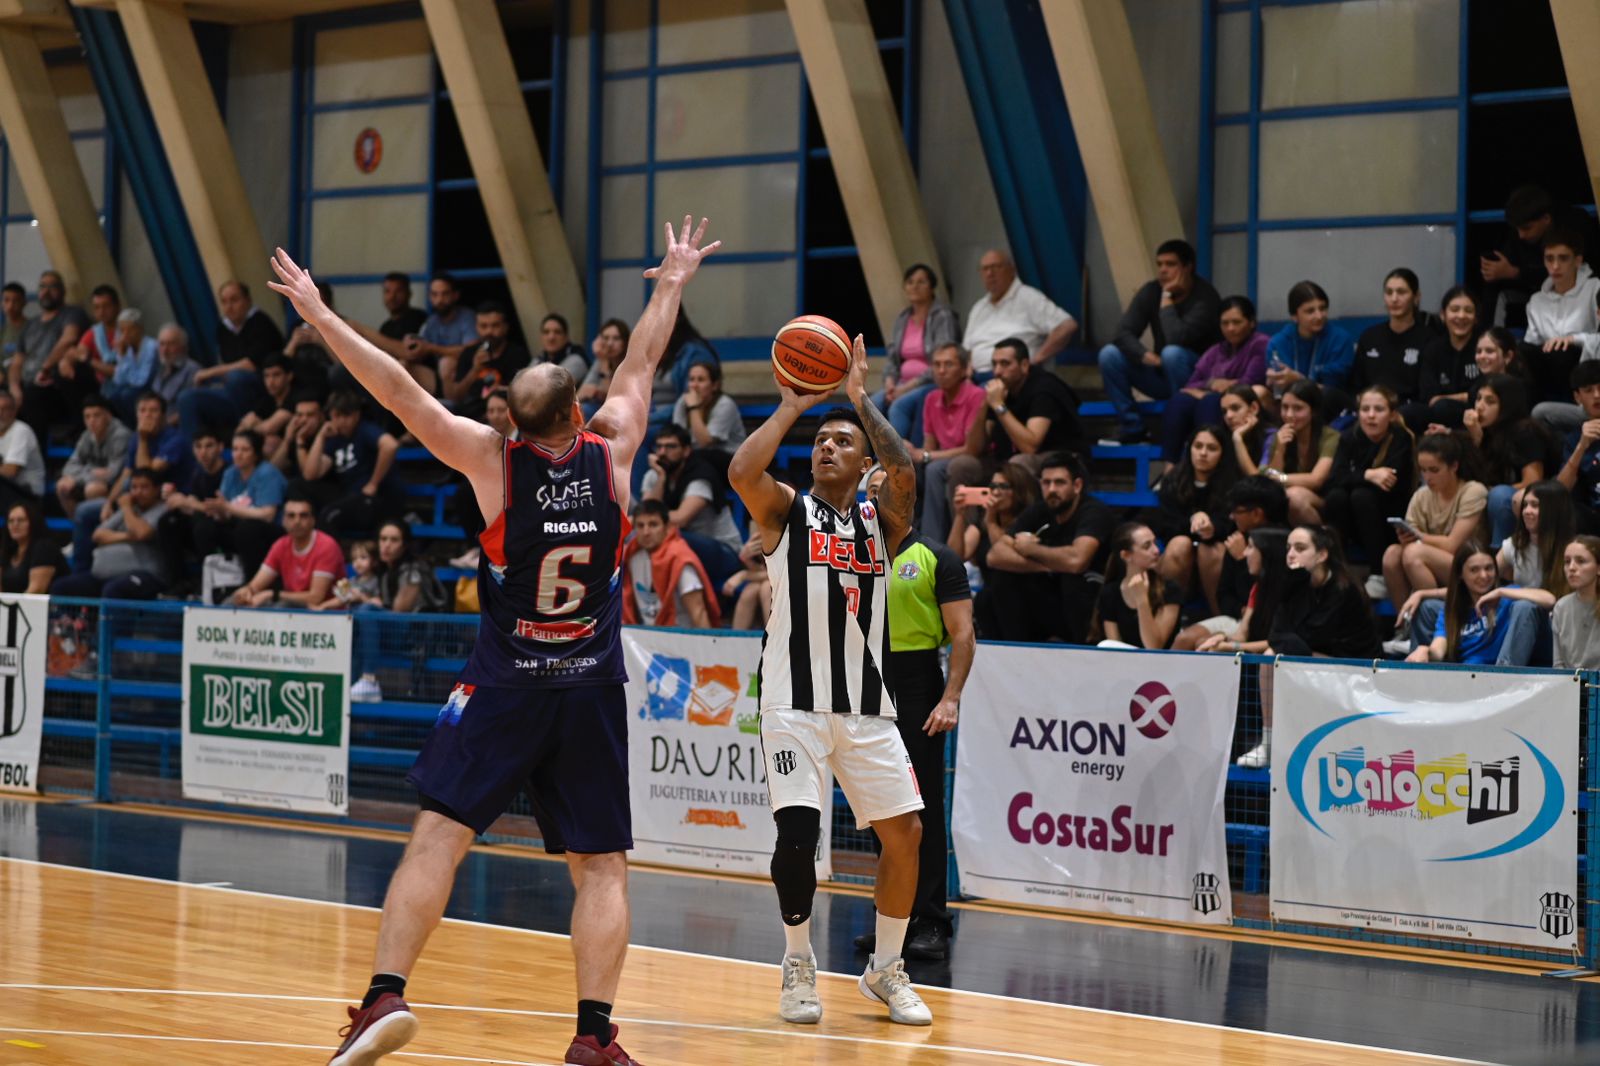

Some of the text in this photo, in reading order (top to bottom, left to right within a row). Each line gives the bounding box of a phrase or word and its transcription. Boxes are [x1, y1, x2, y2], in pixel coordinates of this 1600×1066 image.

[784, 352, 829, 379] molten
[543, 521, 598, 534] RIGADA
[809, 528, 884, 575] BELL
[536, 545, 592, 615] 6
[197, 626, 337, 650] SODA Y AGUA DE MESA
[515, 657, 598, 669] SAN FRANCISCO
[203, 673, 325, 737] BELSI
[1009, 716, 1126, 757] AXION
[651, 735, 766, 785] DAURI
[1071, 759, 1125, 781] energy
[650, 784, 771, 807] JUGUETERIA Y LIBRE
[1326, 750, 1513, 812] baiocchi
[1007, 791, 1174, 857] CostaSur
